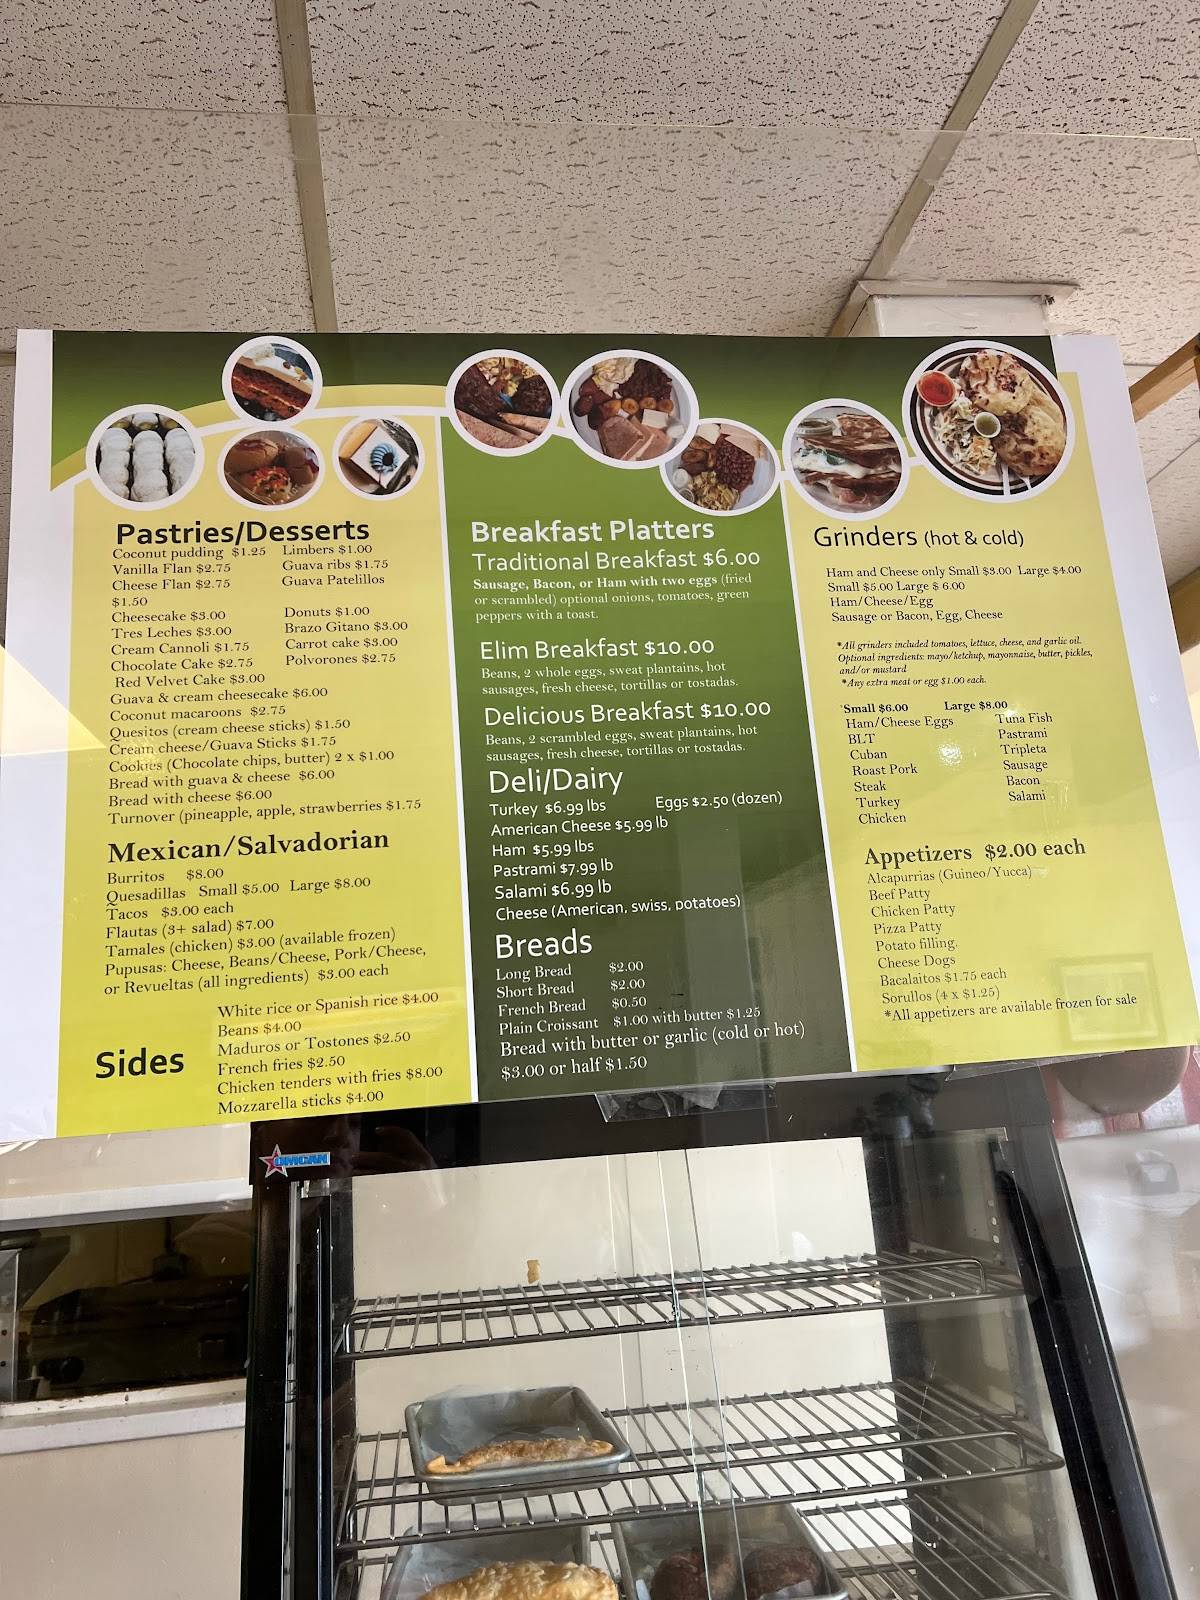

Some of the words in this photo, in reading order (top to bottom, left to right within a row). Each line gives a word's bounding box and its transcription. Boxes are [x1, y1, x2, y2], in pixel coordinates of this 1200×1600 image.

[117, 520, 370, 546] Pastries/Desserts
[471, 519, 603, 543] Breakfast
[609, 518, 715, 541] Platters
[814, 525, 918, 547] Grinders
[924, 530, 961, 549] (hot
[964, 530, 978, 546] &
[982, 529, 1024, 548] cold)
[112, 548, 167, 560] Coconut
[171, 546, 224, 562] pudding
[231, 547, 266, 558] $1.25
[282, 543, 335, 556] Limbers
[338, 544, 373, 555] $1.00
[282, 560, 324, 571] Guava
[327, 558, 351, 570] ribs
[354, 559, 389, 571] $1.75
[471, 551, 590, 571] Traditional
[596, 548, 698, 570] Breakfast
[703, 548, 760, 567] $6.00
[281, 575, 323, 587] Guava
[327, 573, 385, 585] Patelillos
[579, 580, 593, 589] or
[597, 577, 627, 588] Ham
[630, 575, 658, 587] with
[661, 577, 685, 586] two
[688, 576, 718, 589] eggs
[111, 610, 187, 623] Cheesecake
[190, 610, 226, 623] $3.00
[284, 607, 332, 618] Donuts
[335, 606, 370, 618] $1.00
[831, 611, 878, 625] Sausage
[880, 613, 893, 621] or
[895, 610, 933, 622] Bacon,
[936, 609, 963, 624] Egg,
[964, 609, 1003, 620] Cheese
[284, 622, 322, 634] Brazo
[325, 621, 370, 633] Gitano
[373, 621, 408, 632] $3.00
[111, 644, 155, 656] Cream
[159, 641, 209, 654] Cannoli
[214, 642, 250, 654] $1.75
[481, 640, 529, 660] Elim
[535, 637, 639, 659] Breakfast
[644, 640, 715, 656] $10.00
[111, 659, 177, 672] Chocolate
[181, 658, 214, 670] Cake
[217, 657, 253, 669] $2.75
[523, 669, 531, 678] 2
[535, 666, 571, 678] whole
[609, 666, 643, 676] sweat
[706, 660, 726, 672] hot
[115, 676, 141, 688] Red
[146, 675, 189, 687] Velvet
[193, 673, 226, 686] Cake
[229, 673, 266, 686] $3.00
[485, 705, 585, 726] Delicious
[591, 700, 695, 723] Breakfast
[700, 701, 771, 719] $10.00
[845, 716, 921, 729] Ham/Cheese
[923, 716, 954, 730] Eggs
[848, 733, 876, 745] BLT
[998, 727, 1048, 740] Pastrami
[850, 749, 888, 761] Cuban
[1000, 743, 1048, 758] Tripleta
[852, 765, 887, 776] Roast
[889, 763, 919, 775] Pork
[489, 766, 624, 796] Deli/Dairy
[109, 793, 148, 807] Bread
[153, 792, 183, 805] with
[187, 791, 232, 804] cheese
[235, 789, 273, 802] $6.00
[489, 802, 538, 819] Turkey
[545, 800, 584, 816] $6.99
[587, 798, 607, 812] lbs
[491, 822, 558, 837] American
[561, 819, 612, 833] Cheese
[615, 819, 653, 833] $5.99
[655, 814, 669, 828] lb
[108, 829, 389, 863] Mexican/Salvadorian
[865, 845, 973, 869] Appetizers
[984, 843, 1037, 862] $2.00
[1043, 838, 1086, 856] each
[107, 870, 165, 885] Burritos
[186, 868, 224, 881] $8.00
[493, 861, 556, 878] Pastrami
[560, 862, 598, 877] $7.99
[600, 857, 614, 871] lb
[106, 887, 186, 906] Quesadillas
[199, 883, 237, 897] Small
[242, 882, 280, 895] $5.00
[290, 879, 330, 894] Large
[334, 877, 371, 890] $8.00
[105, 908, 148, 921] Tacos
[161, 905, 200, 919] $3.00
[203, 901, 234, 915] each
[871, 904, 920, 918] Chicken
[923, 903, 956, 918] Patty
[105, 942, 165, 958] Tamales
[170, 937, 233, 957] (chicken)
[237, 937, 275, 951] $3.00
[279, 930, 344, 950] (available
[348, 927, 396, 943] frozen)
[496, 928, 593, 959] Breads
[105, 963, 167, 979] Pupusas:
[171, 958, 225, 972] Cheese,
[229, 951, 330, 968] Beans/Cheese,
[335, 944, 426, 961] Pork/Cheese,
[609, 960, 644, 974] $2.00
[877, 956, 920, 969] Cheese
[924, 954, 956, 970] Dogs
[496, 968, 531, 983] Long
[535, 963, 572, 978] Bread
[880, 972, 941, 987] Bacalaitos
[944, 970, 977, 984] $1.75
[980, 967, 1007, 980] each
[217, 1003, 262, 1018] White
[267, 1001, 292, 1015] rice
[296, 1003, 312, 1013] or
[315, 995, 369, 1015] Spanish
[373, 993, 398, 1007] rice
[402, 992, 439, 1006] $4.00
[499, 1021, 533, 1036] Plain
[537, 1018, 599, 1033] Croissant
[96, 1047, 184, 1079] Sides
[218, 1059, 268, 1076] French
[273, 1057, 303, 1072] fries
[307, 1055, 346, 1071] $2.50
[501, 1064, 545, 1082] $3.00
[549, 1064, 567, 1076] or
[571, 1057, 602, 1074] half
[605, 1055, 648, 1074] $1.50
[218, 1096, 298, 1115] Mozzarella
[302, 1092, 342, 1108] sticks
[346, 1090, 384, 1105] $4.00
